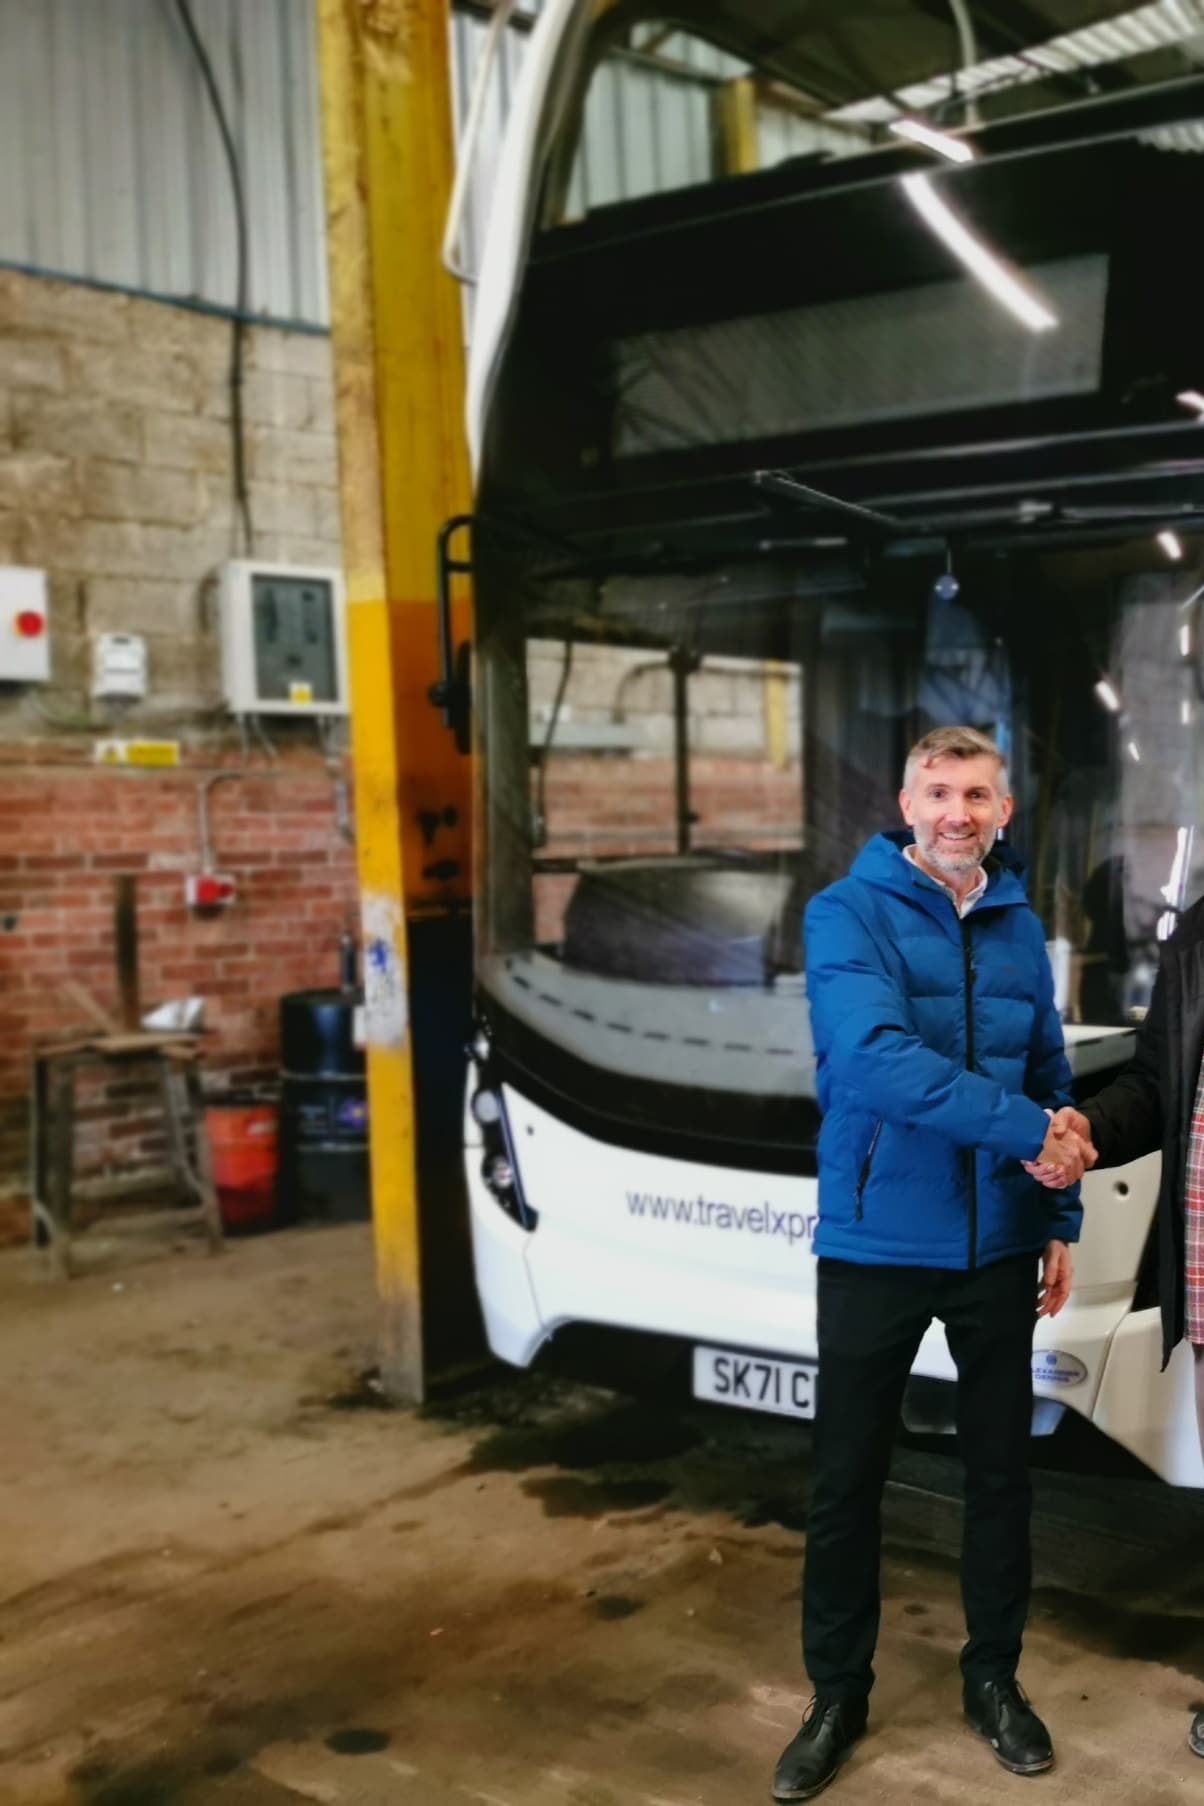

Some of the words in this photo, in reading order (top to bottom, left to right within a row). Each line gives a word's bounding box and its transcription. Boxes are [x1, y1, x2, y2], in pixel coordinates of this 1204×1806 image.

[626, 1190, 818, 1246] www.travelxpr
[713, 1355, 781, 1405] SK71
[792, 1370, 811, 1409] C
